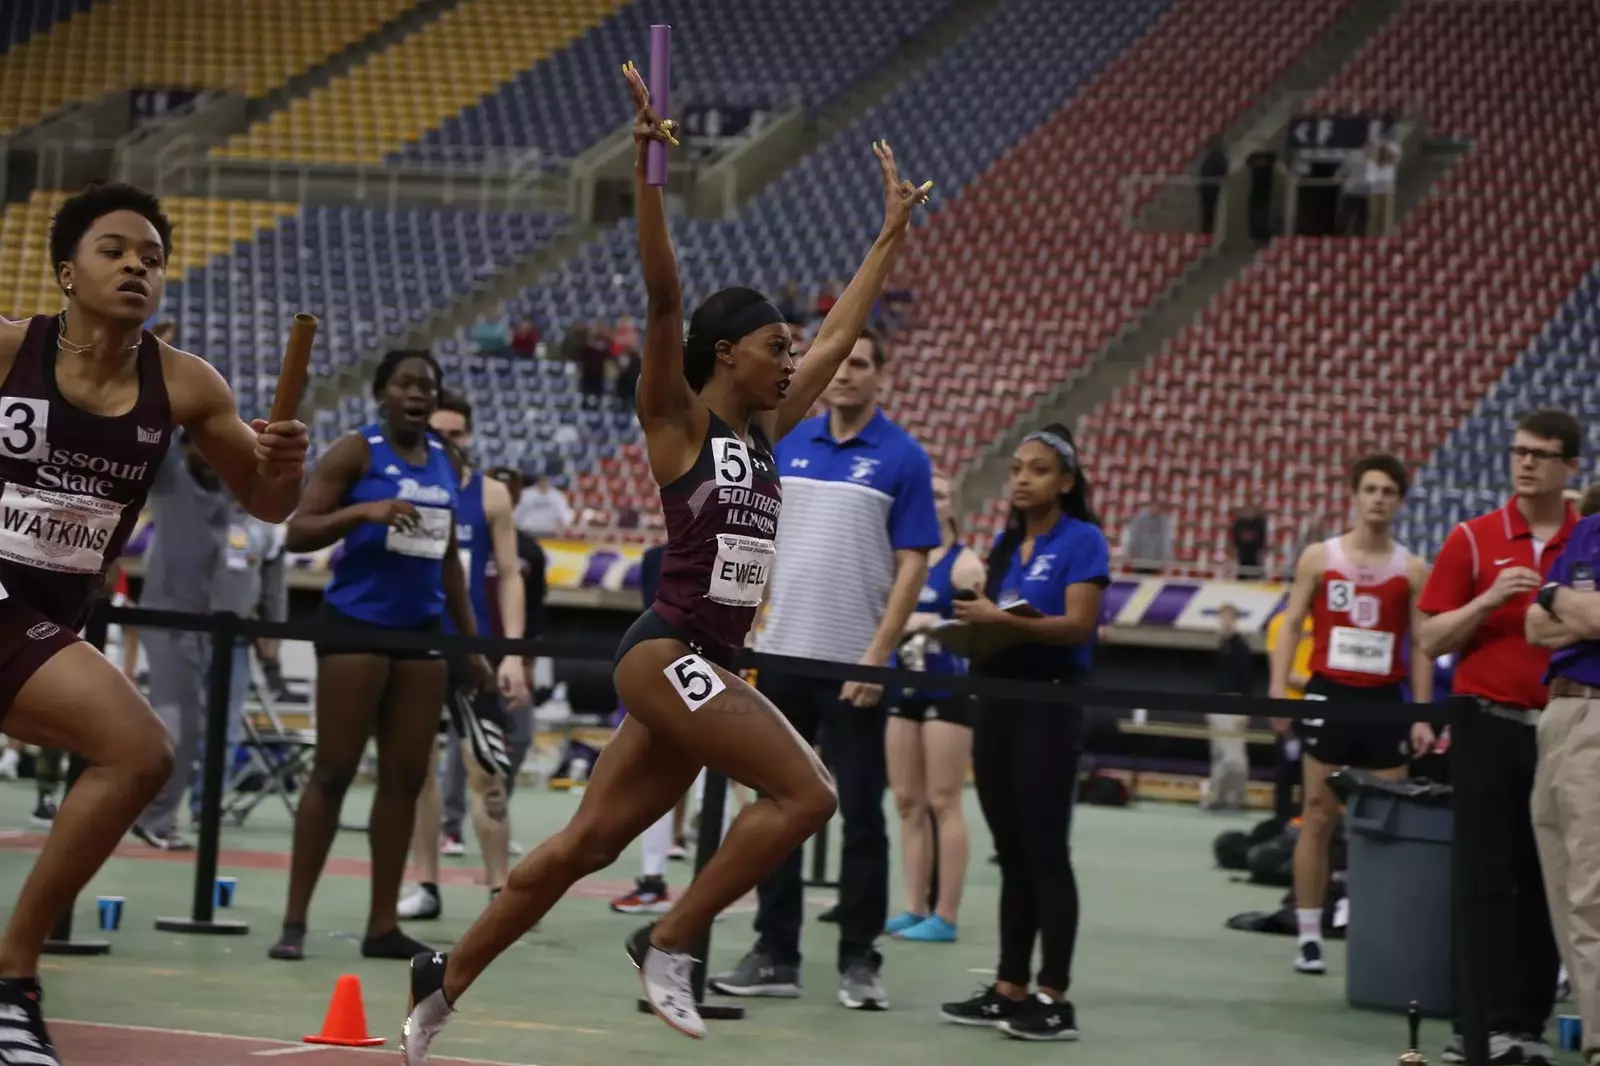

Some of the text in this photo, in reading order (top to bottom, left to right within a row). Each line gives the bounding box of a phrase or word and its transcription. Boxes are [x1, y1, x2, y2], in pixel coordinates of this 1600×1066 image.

[2, 403, 37, 454] 3
[42, 442, 148, 480] issouri
[721, 442, 747, 483] 5
[36, 465, 114, 496] State
[718, 488, 781, 518] SOUTHER
[4, 506, 108, 551] WATKINS
[725, 508, 775, 534] ILLINOIS
[0, 549, 36, 565] NIVERSITY
[720, 561, 766, 585] EWELL
[1332, 584, 1348, 608] 3
[675, 657, 714, 702] 5
